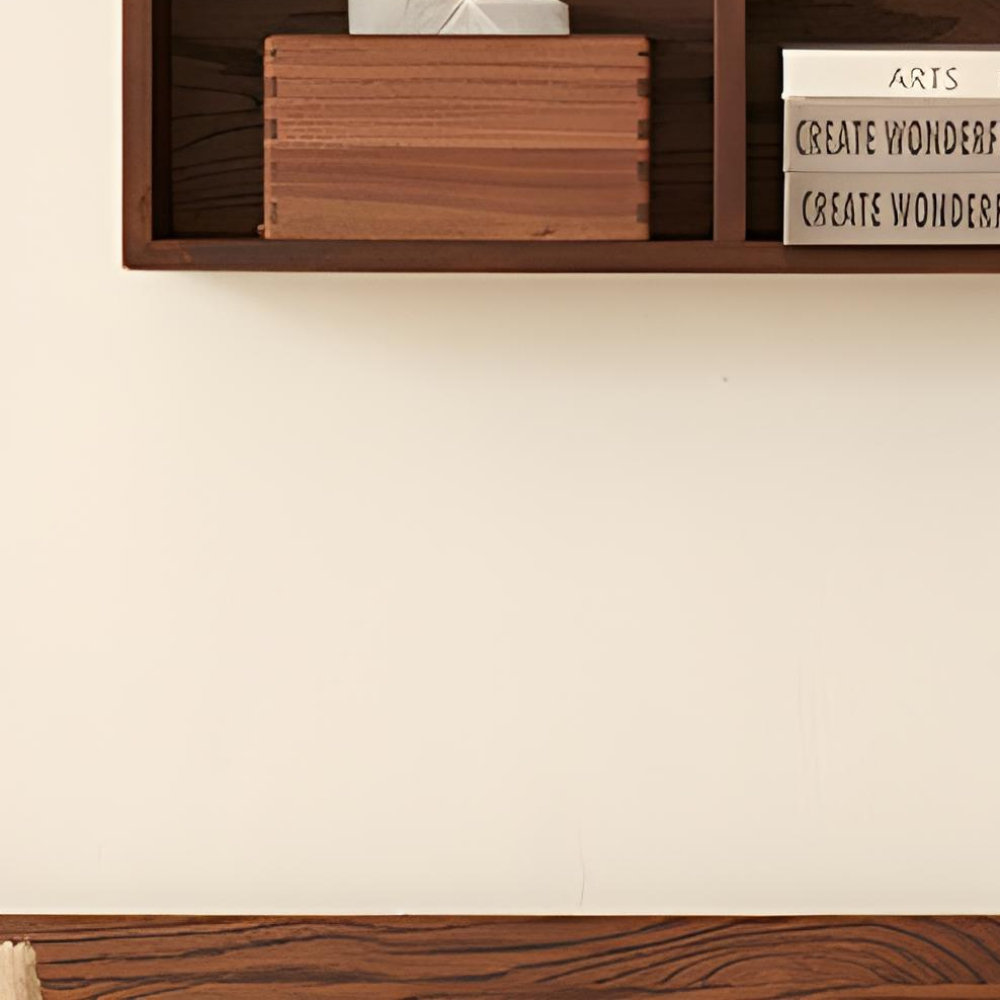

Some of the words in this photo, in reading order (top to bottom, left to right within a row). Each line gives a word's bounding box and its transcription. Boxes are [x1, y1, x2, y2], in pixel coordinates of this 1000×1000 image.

[889, 67, 958, 90] ARTS
[796, 120, 876, 155] CREATE
[802, 191, 881, 227] CREATE
